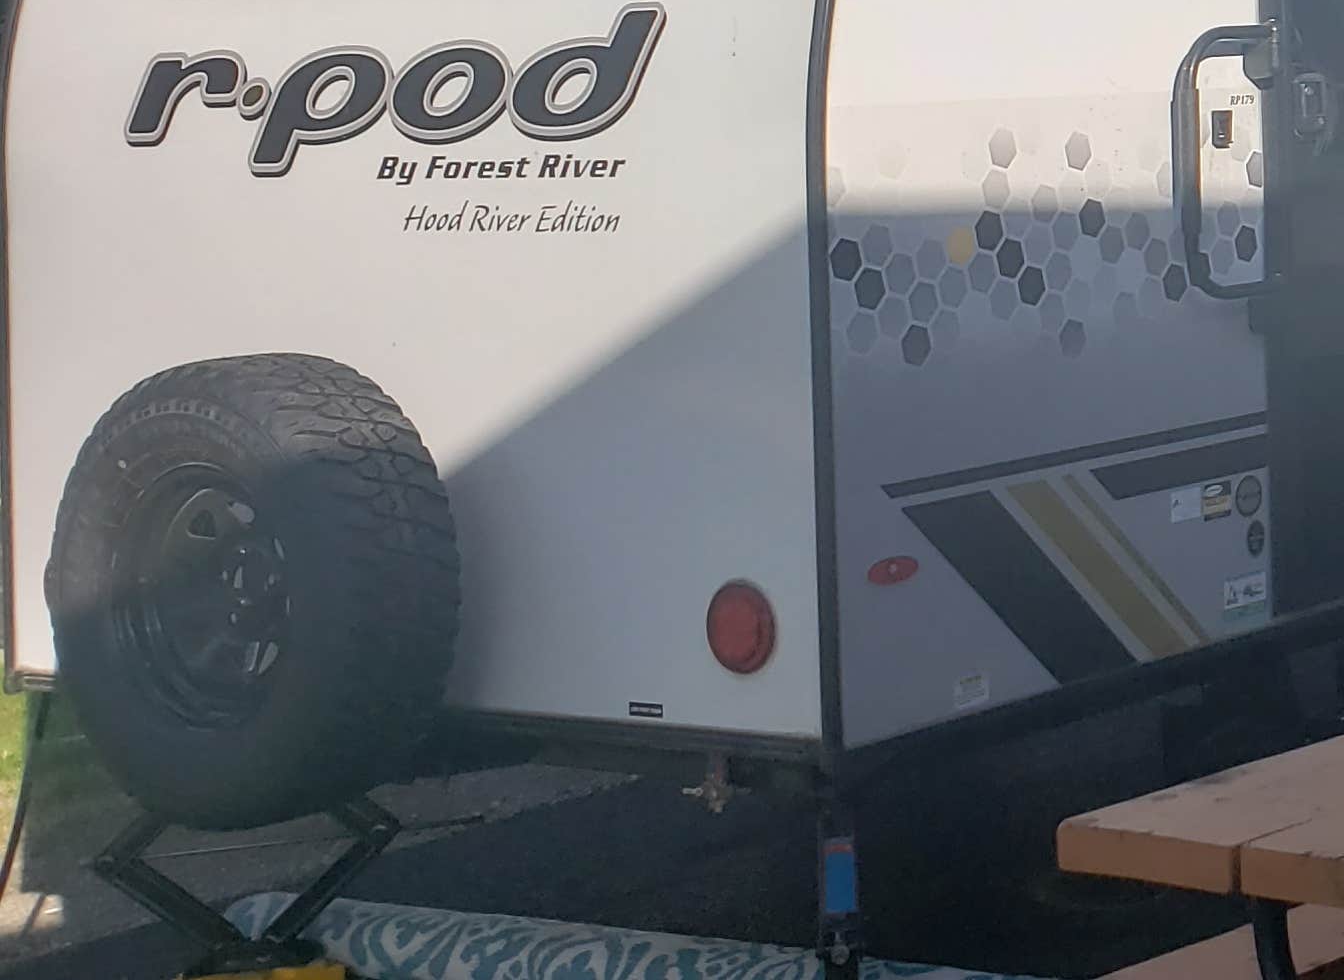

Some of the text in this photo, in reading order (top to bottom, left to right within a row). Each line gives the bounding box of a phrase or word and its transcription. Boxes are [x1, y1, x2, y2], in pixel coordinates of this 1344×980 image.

[376, 154, 626, 186] By Forest River
[403, 200, 621, 233] Hood River Edition
